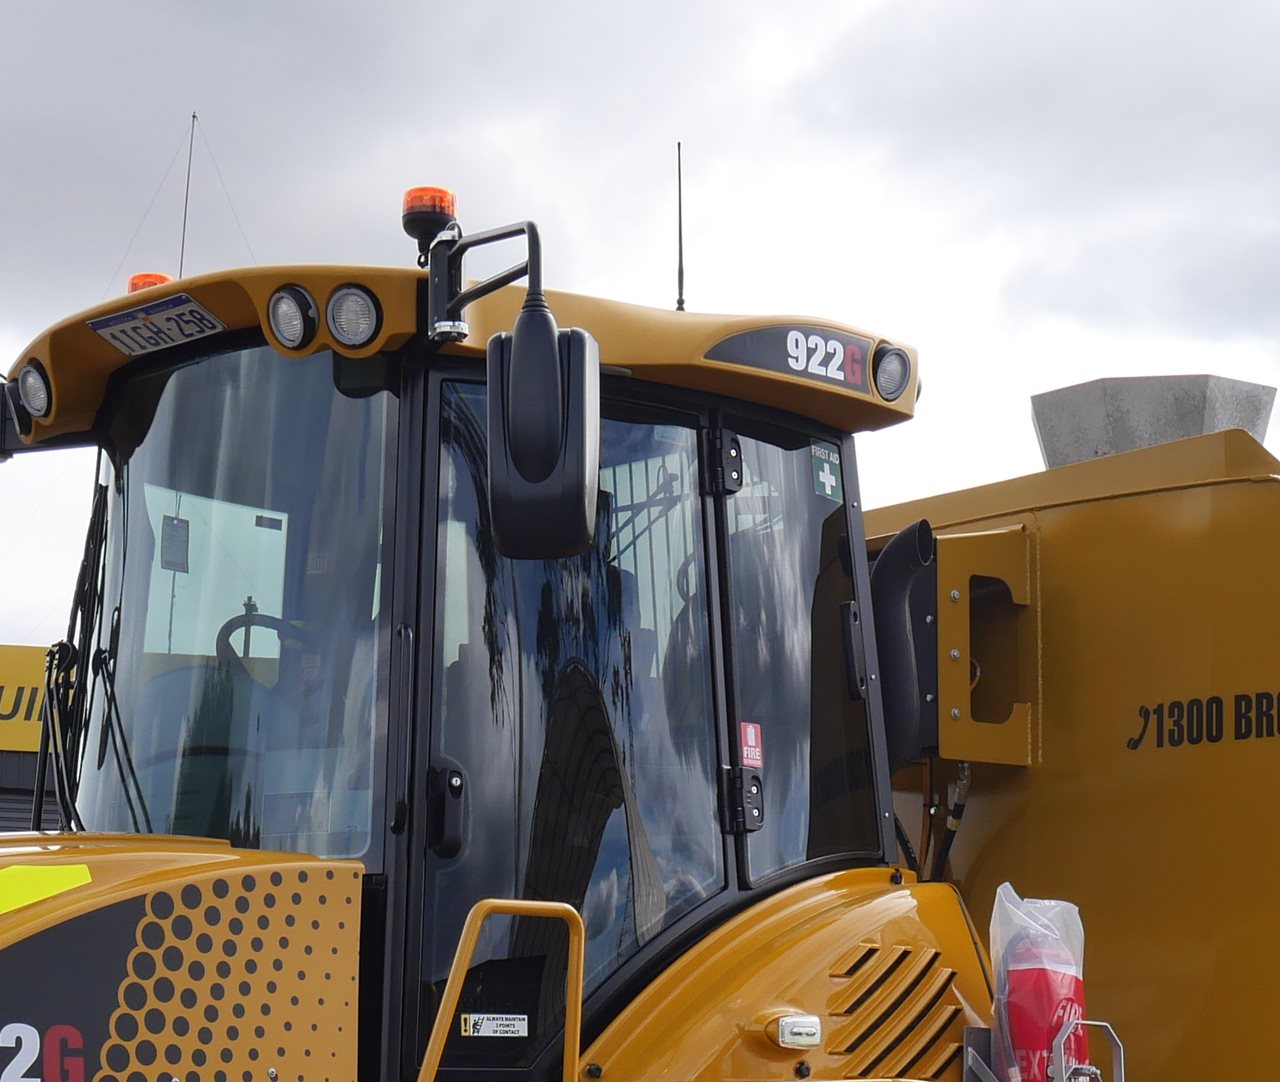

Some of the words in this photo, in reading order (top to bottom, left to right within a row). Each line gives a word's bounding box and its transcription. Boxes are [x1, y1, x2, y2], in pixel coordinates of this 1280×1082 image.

[786, 330, 862, 385] 922G
[811, 445, 828, 460] FIRST
[830, 451, 840, 464] AID
[1152, 695, 1224, 749] 1300
[743, 746, 761, 760] FIRE
